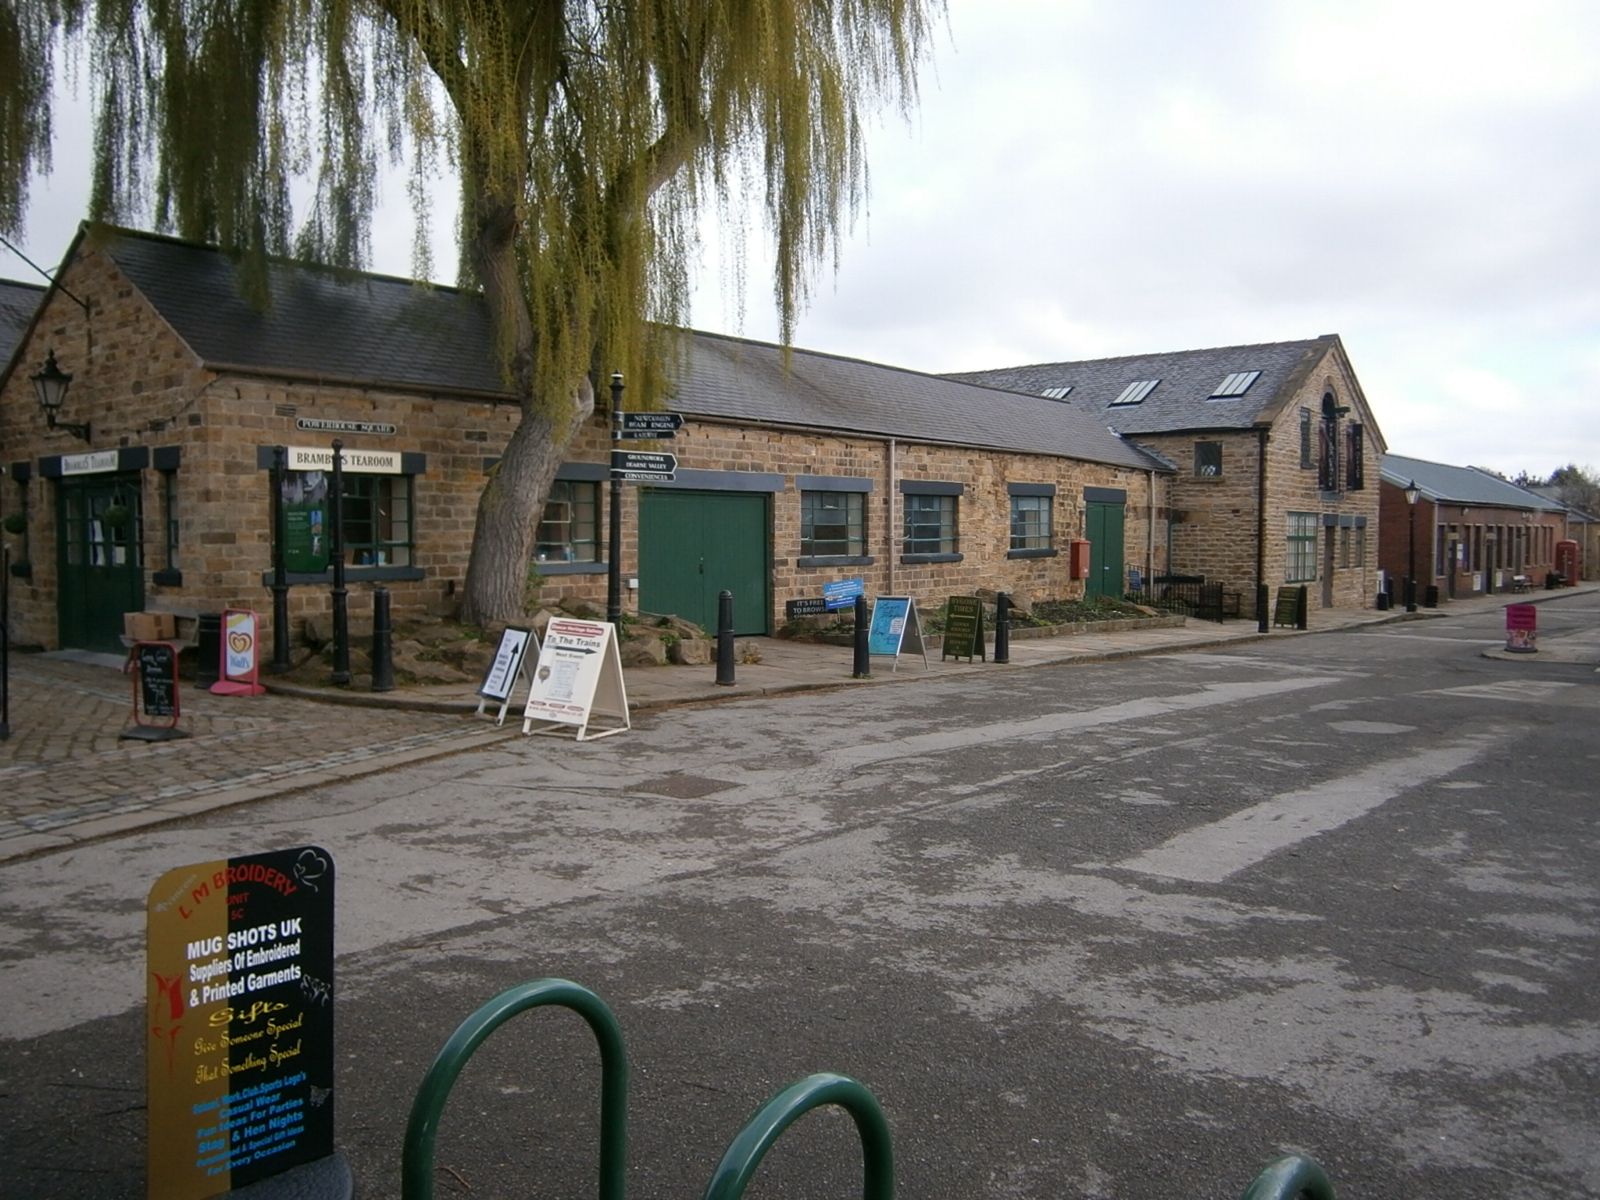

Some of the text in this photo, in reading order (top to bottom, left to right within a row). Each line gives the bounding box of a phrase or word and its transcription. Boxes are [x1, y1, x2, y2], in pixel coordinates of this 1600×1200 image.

[302, 419, 391, 433] POWERHOUSE SQUARE
[297, 452, 393, 467] BRAMBS TEAROOM
[627, 454, 665, 462] GROUNDWORK
[951, 598, 978, 606] BYGONE
[953, 605, 974, 613] TIMES
[547, 635, 601, 647] To The Trains
[178, 864, 298, 919] L M BROIDERY
[226, 892, 249, 905] UNIT
[187, 917, 302, 960] MUG SHOTS UK
[190, 938, 301, 983] Suppliers Of Embroidered
[189, 963, 302, 1008] & Printed Garments
[209, 1001, 289, 1027] Gifts
[194, 1012, 304, 1056] Give Someone Special
[195, 1038, 302, 1085] That Something Special
[284, 1071, 307, 1086] Logo's
[218, 1093, 281, 1119] Casual Wear
[219, 1116, 248, 1131] Ideas
[250, 1110, 267, 1121] For
[269, 1098, 304, 1115] Parties
[231, 1130, 241, 1143] &
[243, 1124, 266, 1138] Hen
[268, 1112, 304, 1130] Nights
[241, 1143, 247, 1152] &
[248, 1135, 273, 1150] Special
[273, 1130, 286, 1141] Gift
[287, 1125, 305, 1137] Ideas
[225, 1155, 251, 1170] Every
[254, 1140, 297, 1160] Occasion
